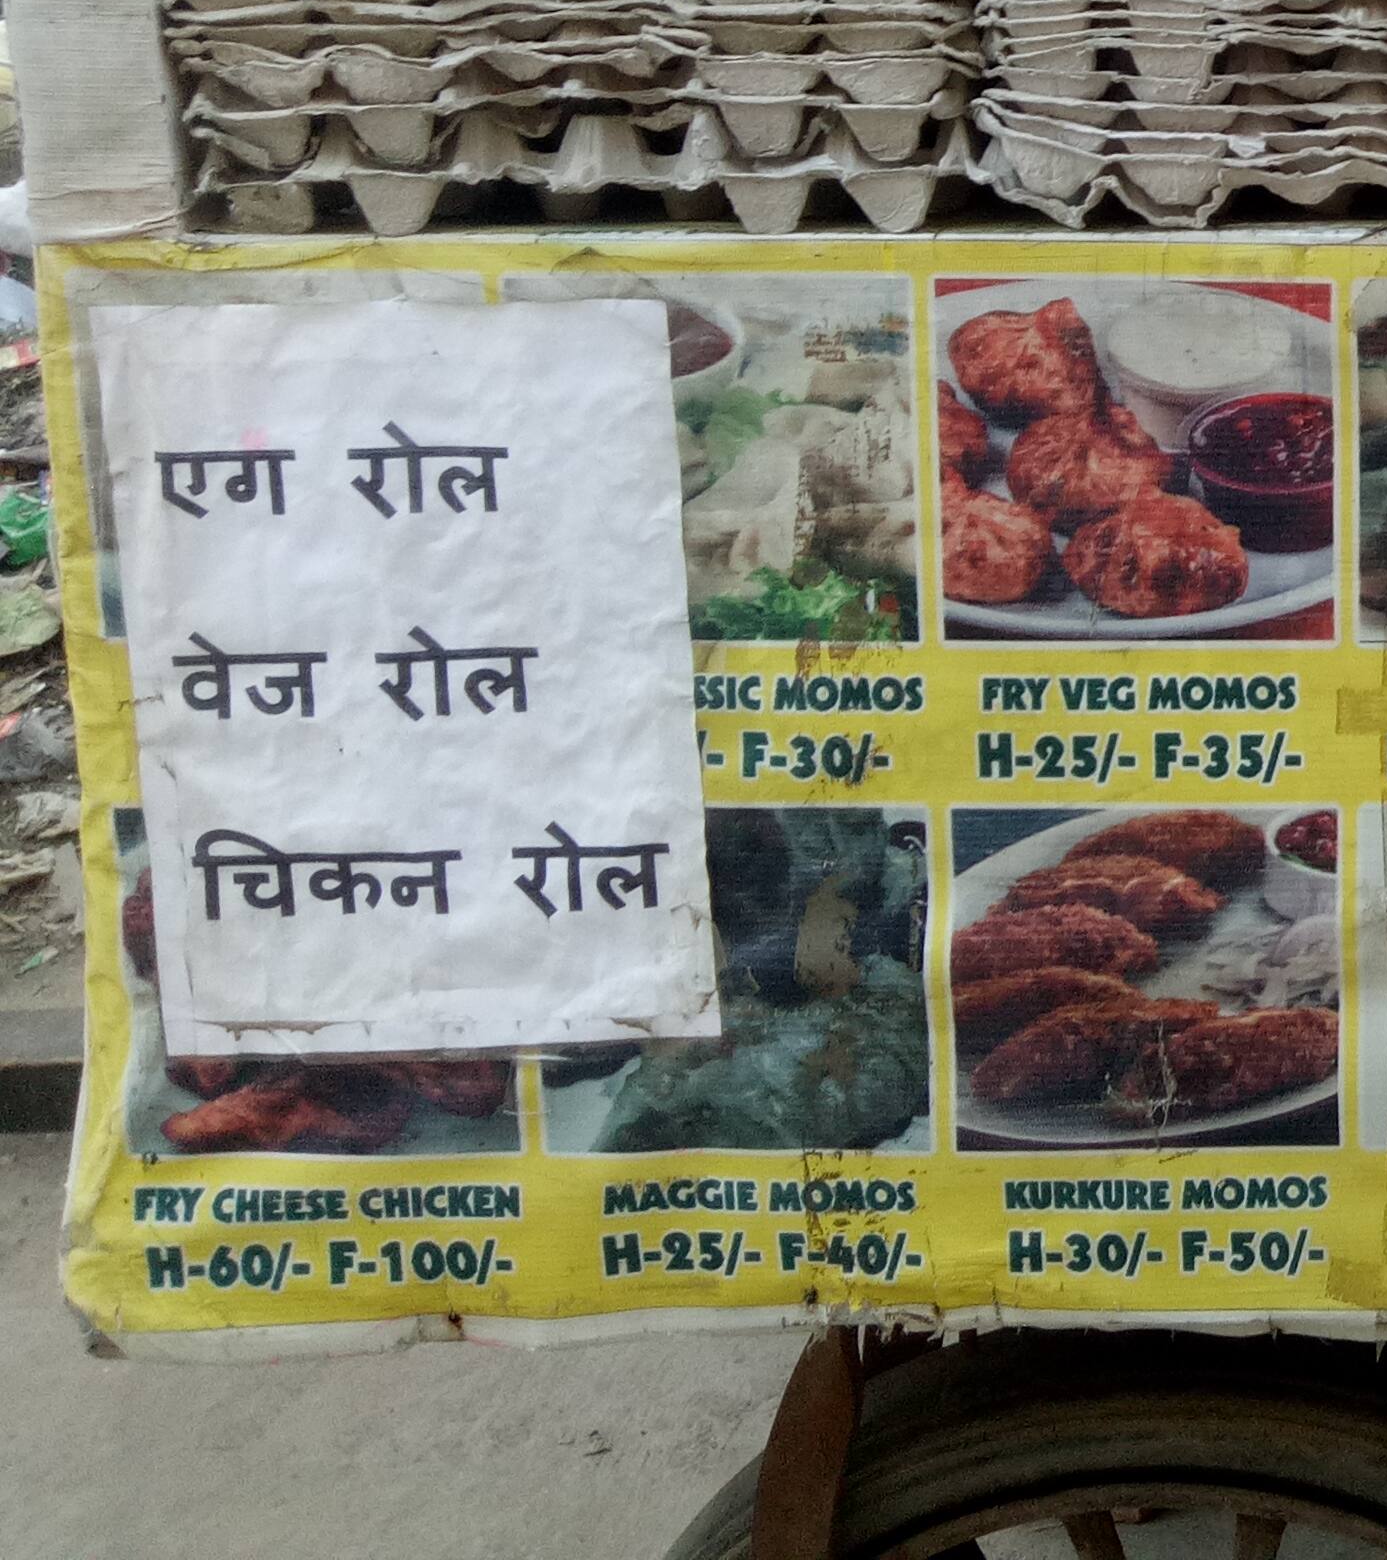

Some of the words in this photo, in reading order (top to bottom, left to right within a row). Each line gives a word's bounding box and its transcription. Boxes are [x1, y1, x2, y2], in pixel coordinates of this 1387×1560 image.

[154, 449, 296, 519] एग
[347, 421, 509, 519] रोल
[171, 631, 328, 720] वेज
[374, 625, 539, 722] रोल
[773, 676, 923, 712] MOMOS
[982, 678, 1050, 711] FRY
[1059, 677, 1136, 711] VEG
[1148, 676, 1296, 711] MOMOS
[742, 731, 889, 786] F-30/-
[978, 732, 1136, 783] H-25/-
[1154, 732, 1302, 783] F-35/-
[191, 828, 462, 921] चिकन
[511, 821, 670, 919] रोल
[134, 1187, 204, 1222] FRY
[212, 1188, 349, 1224] CHEESE
[358, 1185, 520, 1219] CHICKEN
[603, 1179, 758, 1215] MAGGIE
[769, 1175, 916, 1218] MOMOS
[1005, 1179, 1171, 1211] KURKURE
[1181, 1176, 1328, 1210] MOMOS
[145, 1242, 310, 1291] H-60/-
[329, 1239, 512, 1286] F-100/-
[602, 1232, 761, 1276] H-25/-
[779, 1228, 922, 1281] F-40/-
[1009, 1231, 1163, 1277] H-30/-
[1181, 1229, 1324, 1276] F-50/-
